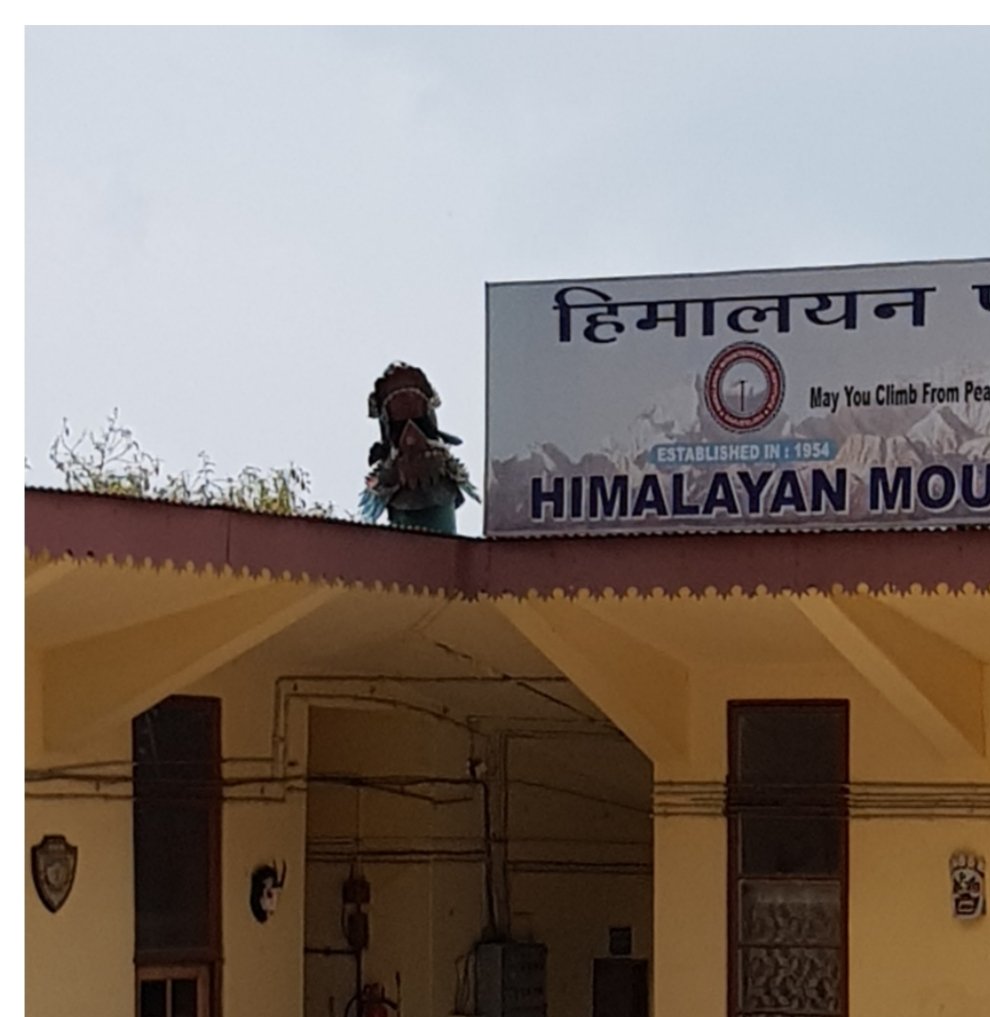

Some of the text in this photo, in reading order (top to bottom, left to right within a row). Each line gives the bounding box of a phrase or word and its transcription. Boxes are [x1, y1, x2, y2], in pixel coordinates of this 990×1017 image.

[553, 287, 936, 343] हिमालयन
[810, 386, 839, 413] May
[844, 385, 871, 407] You
[876, 383, 917, 406] Climb
[922, 382, 959, 403] From
[657, 444, 759, 462] ESTABLISHED
[764, 444, 780, 459] IN
[794, 442, 830, 459] 1954
[530, 466, 848, 520] HIMALAYAN
